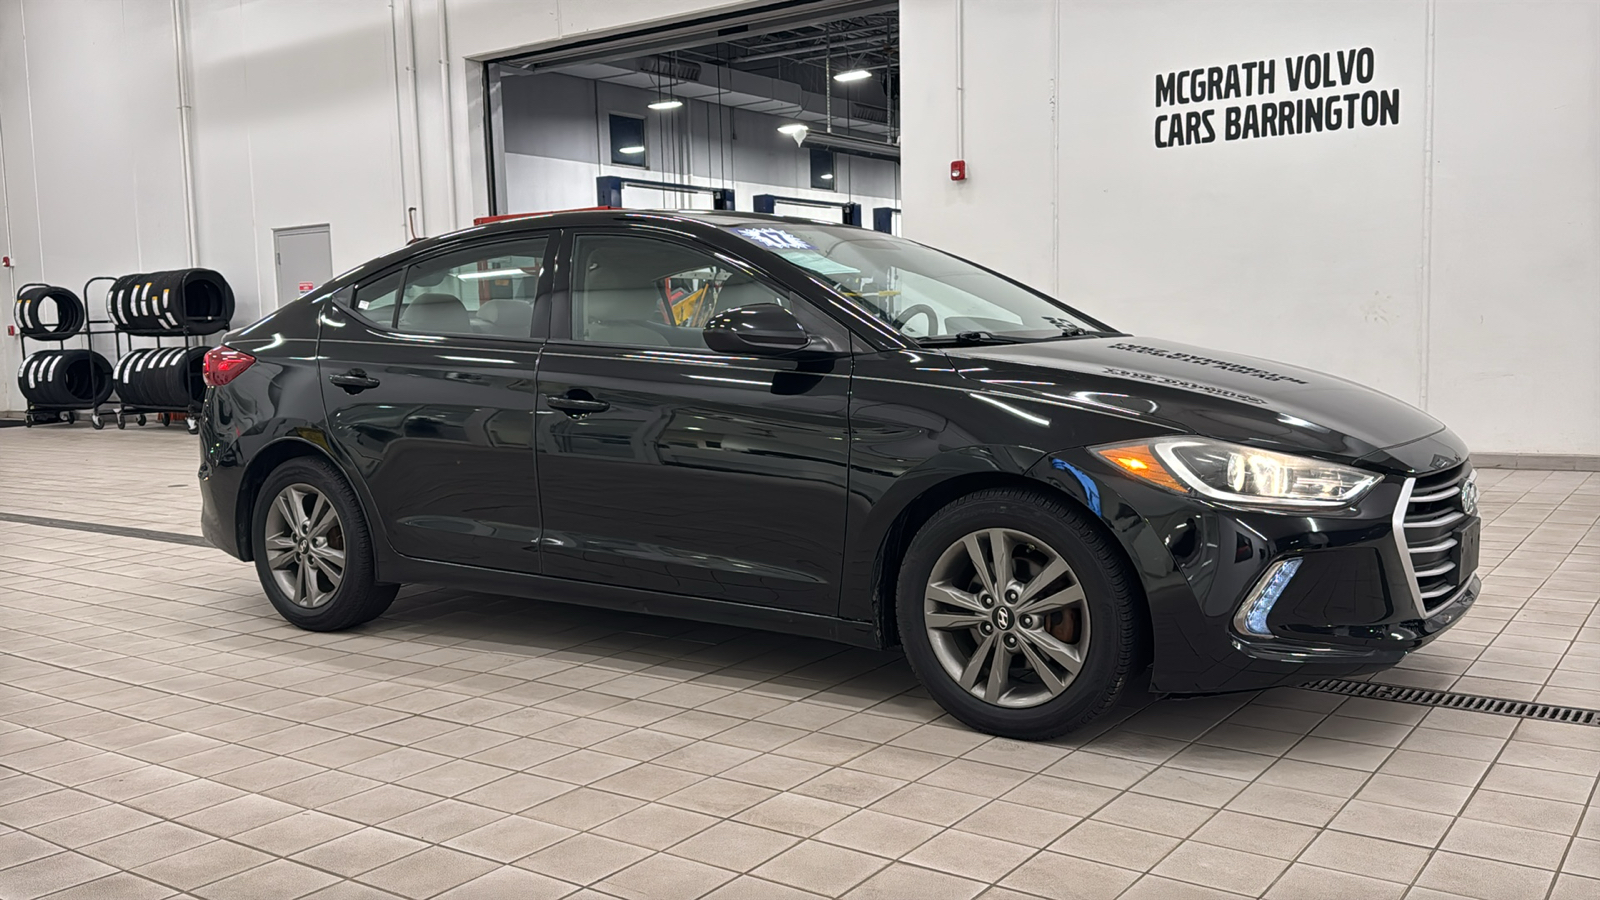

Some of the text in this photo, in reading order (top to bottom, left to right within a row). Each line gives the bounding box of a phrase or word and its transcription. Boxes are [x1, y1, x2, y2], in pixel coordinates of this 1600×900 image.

[1155, 47, 1374, 107] MCGRATH VOLVO
[1155, 89, 1399, 148] CARS BARRINGTON
